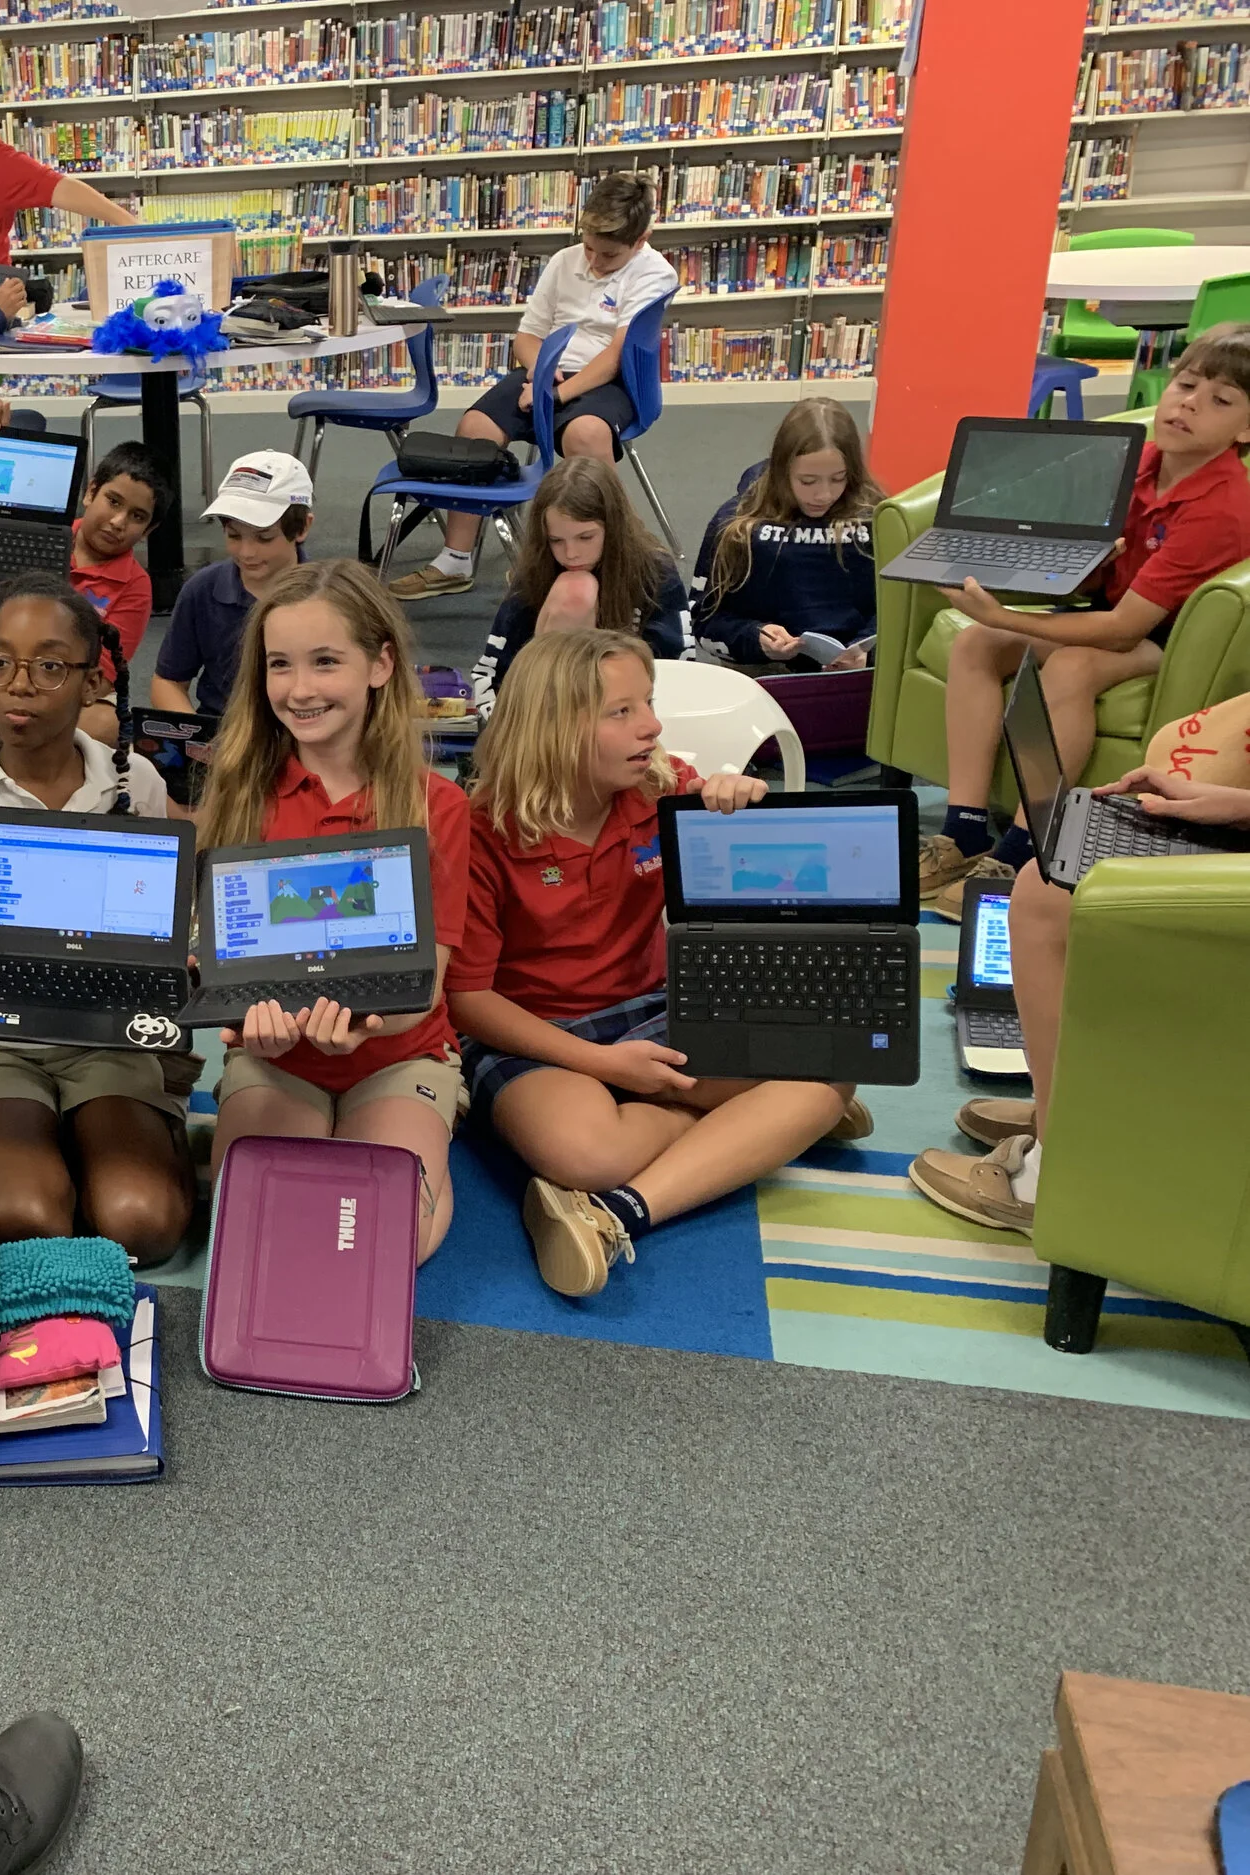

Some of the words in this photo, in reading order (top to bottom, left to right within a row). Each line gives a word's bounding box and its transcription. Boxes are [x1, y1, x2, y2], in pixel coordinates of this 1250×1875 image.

[118, 251, 203, 267] AFTERCARE
[759, 524, 788, 543] ST.
[66, 943, 83, 951] DELL
[307, 965, 326, 973] DELL
[337, 1197, 357, 1252] THULE
